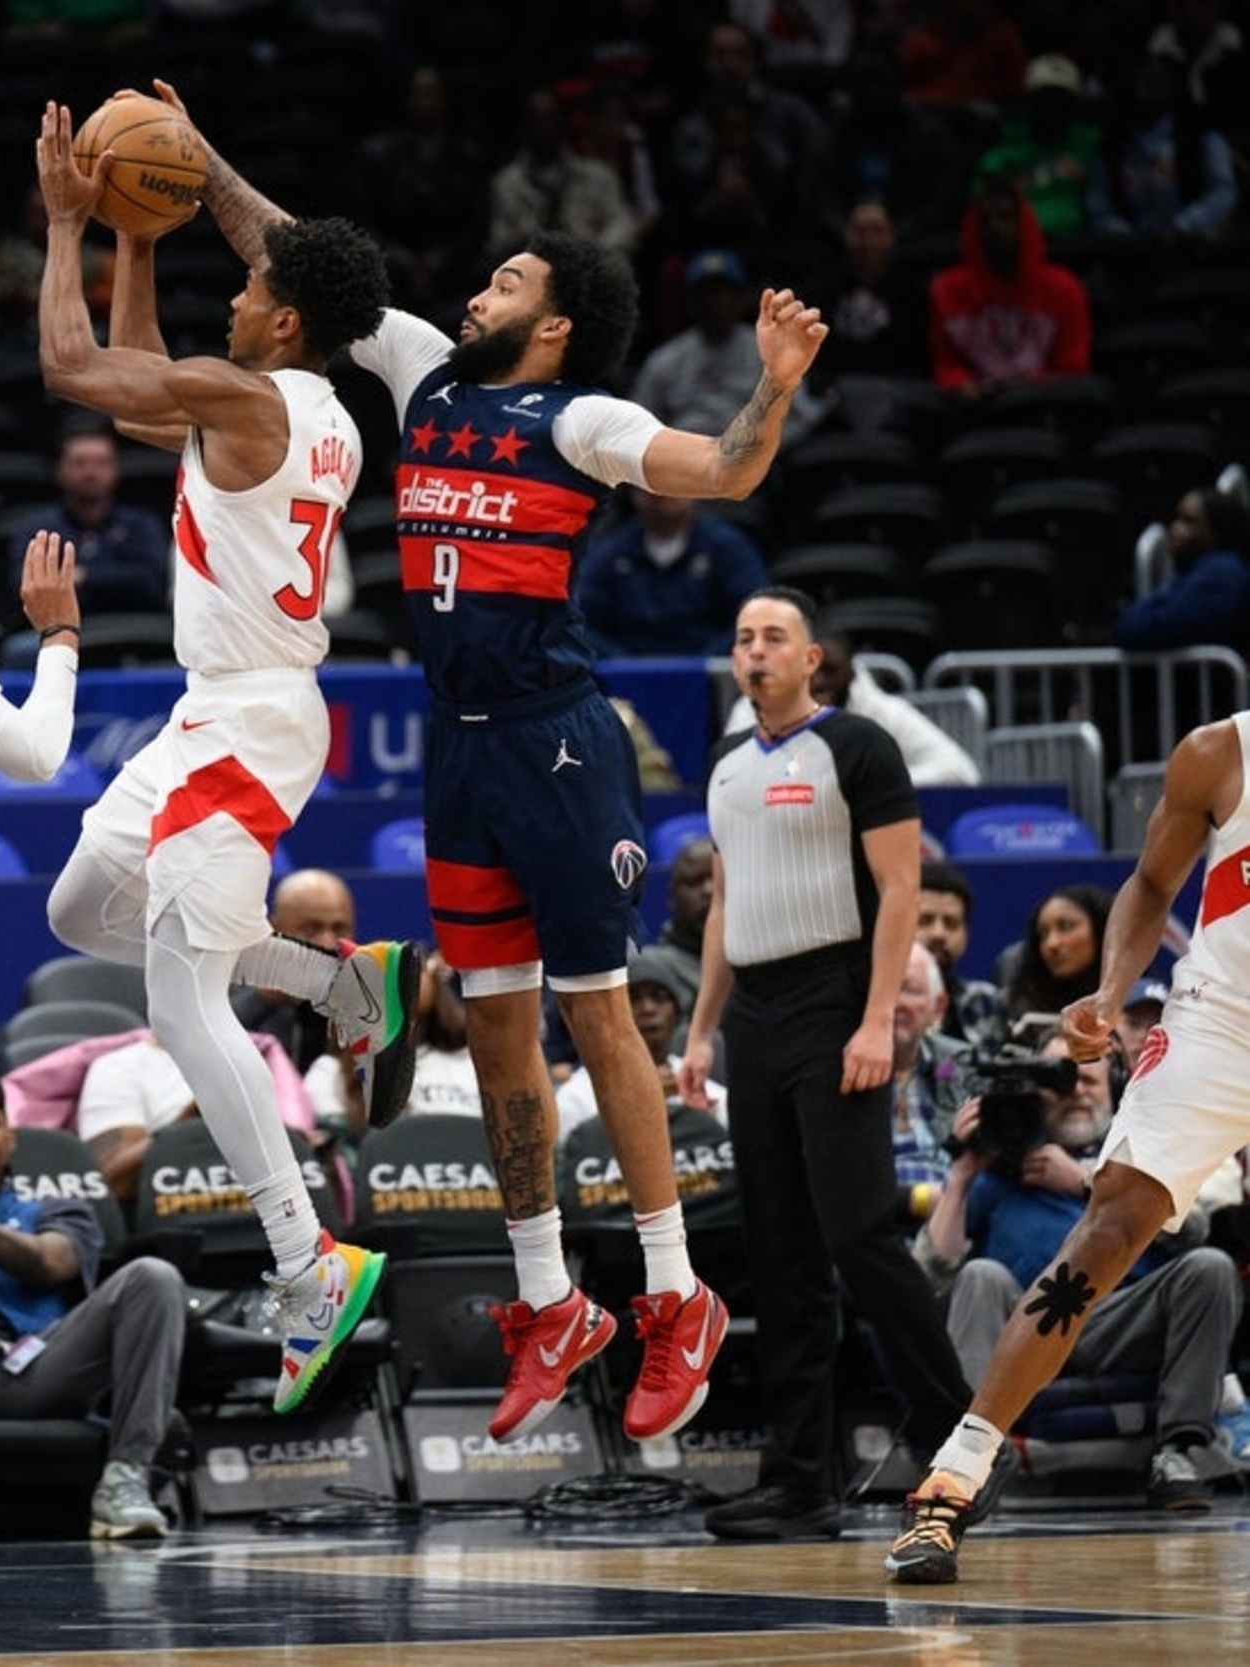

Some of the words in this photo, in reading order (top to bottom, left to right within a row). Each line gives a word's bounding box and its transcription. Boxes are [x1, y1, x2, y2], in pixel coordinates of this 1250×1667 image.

[399, 472, 518, 523] district
[432, 545, 459, 612] 9
[11, 1171, 109, 1201] SARS
[152, 1161, 327, 1195] CAES
[368, 1163, 499, 1192] CAESA
[250, 1435, 369, 1464] CAESARS
